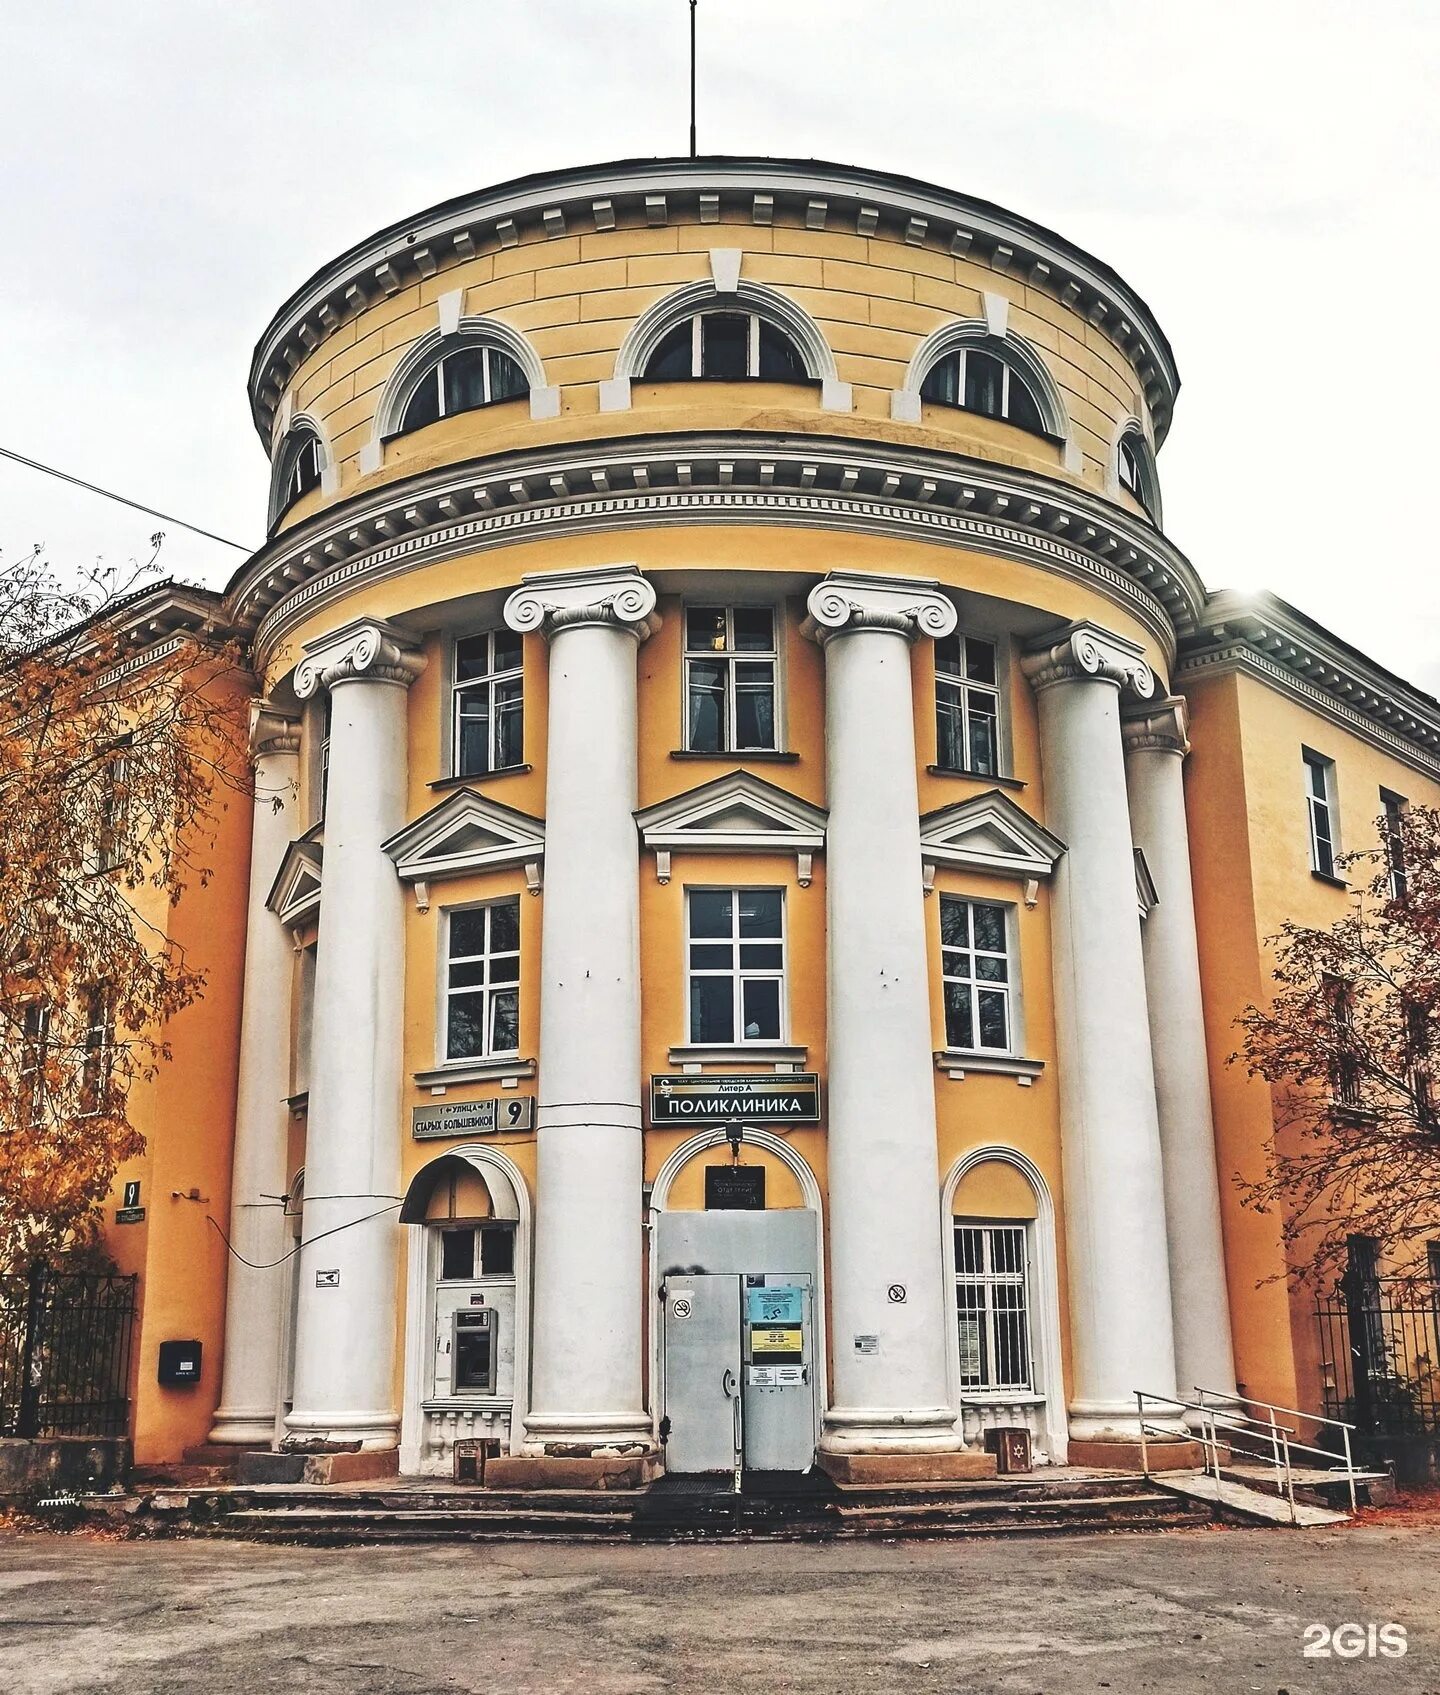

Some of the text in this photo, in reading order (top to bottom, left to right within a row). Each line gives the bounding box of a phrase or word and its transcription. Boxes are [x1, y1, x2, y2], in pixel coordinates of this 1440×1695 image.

[718, 1085, 744, 1093] Литер
[452, 1105, 478, 1113] УЛИЦА
[508, 1101, 523, 1125] 9
[669, 1099, 802, 1114] ПОЛИКЛИНИКА
[415, 1115, 493, 1132] СТАРЫХ БОЛЬШЕВИКОВ
[129, 1184, 135, 1205] 9
